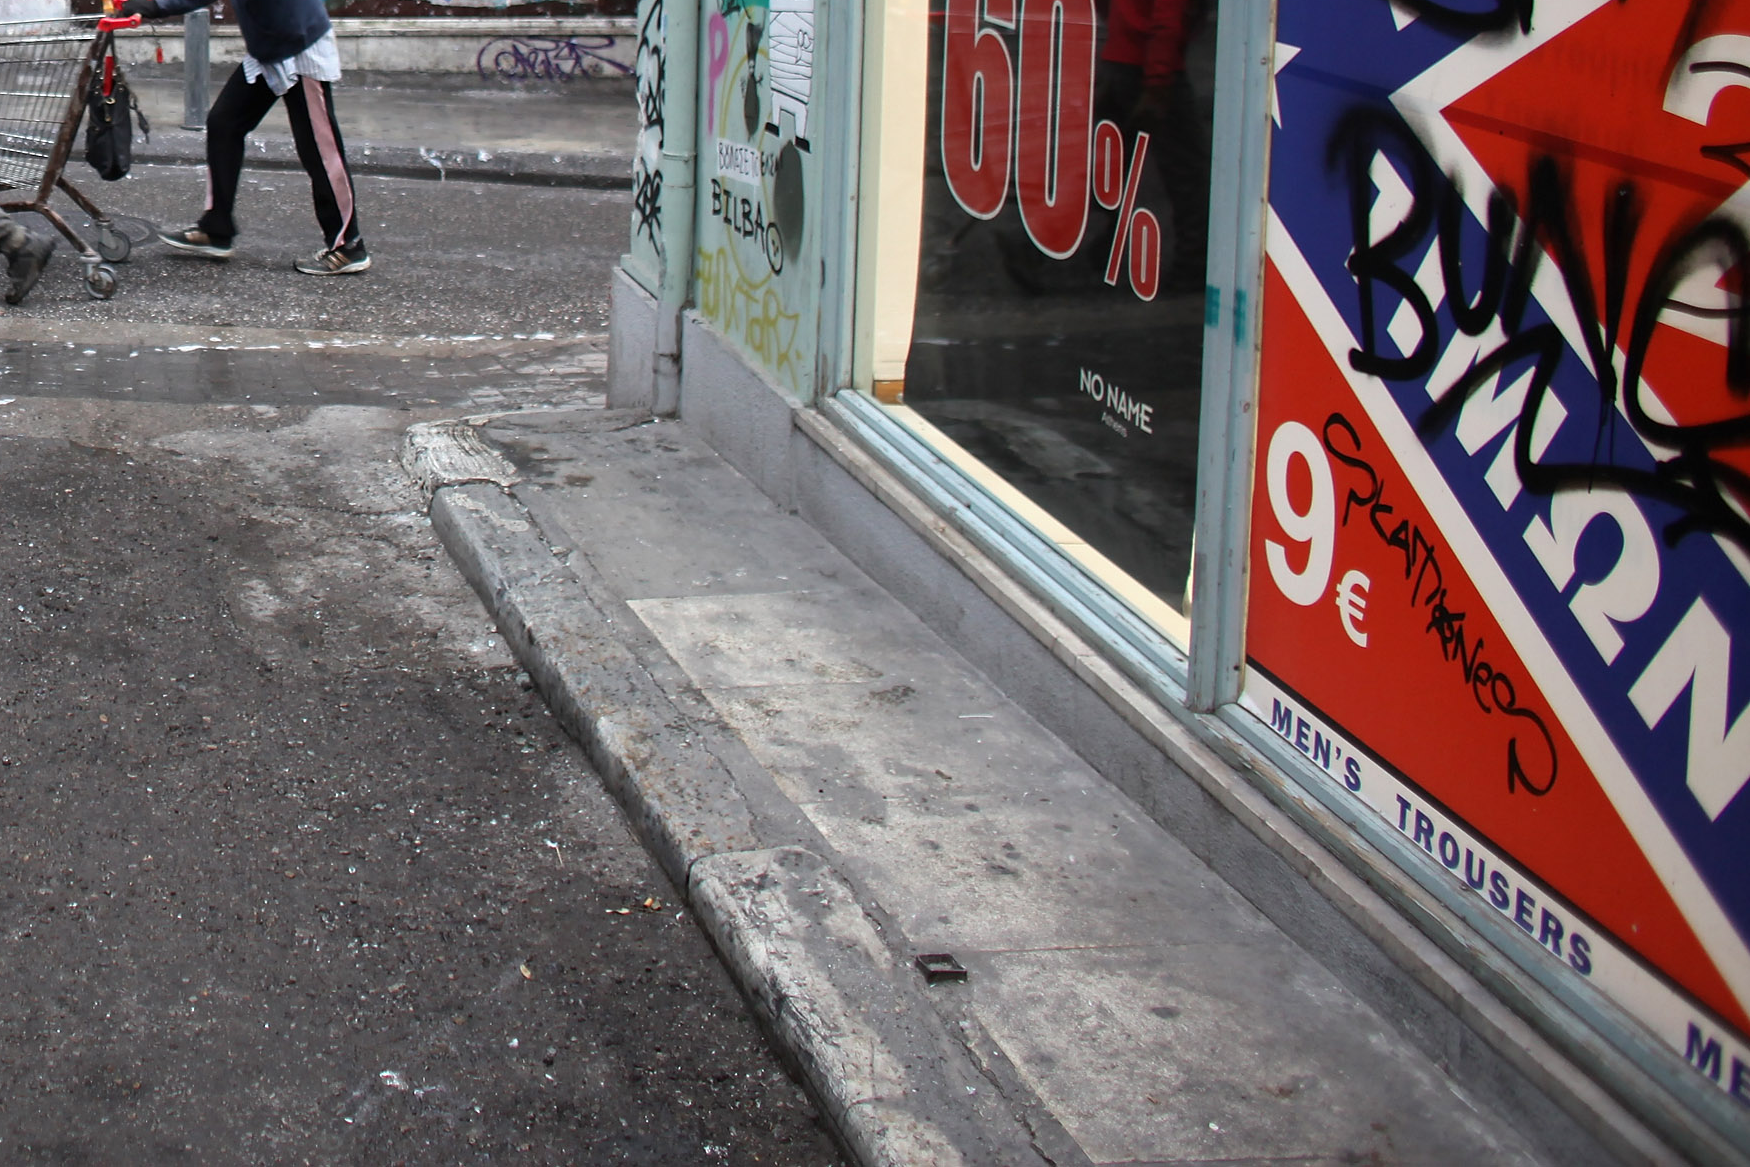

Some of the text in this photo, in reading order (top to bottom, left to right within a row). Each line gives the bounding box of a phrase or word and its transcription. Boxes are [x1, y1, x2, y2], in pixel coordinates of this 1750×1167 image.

[1079, 366, 1154, 435] NO NAME
[1270, 697, 1363, 793] MEN'S
[1394, 793, 1593, 977] TROUSERS
